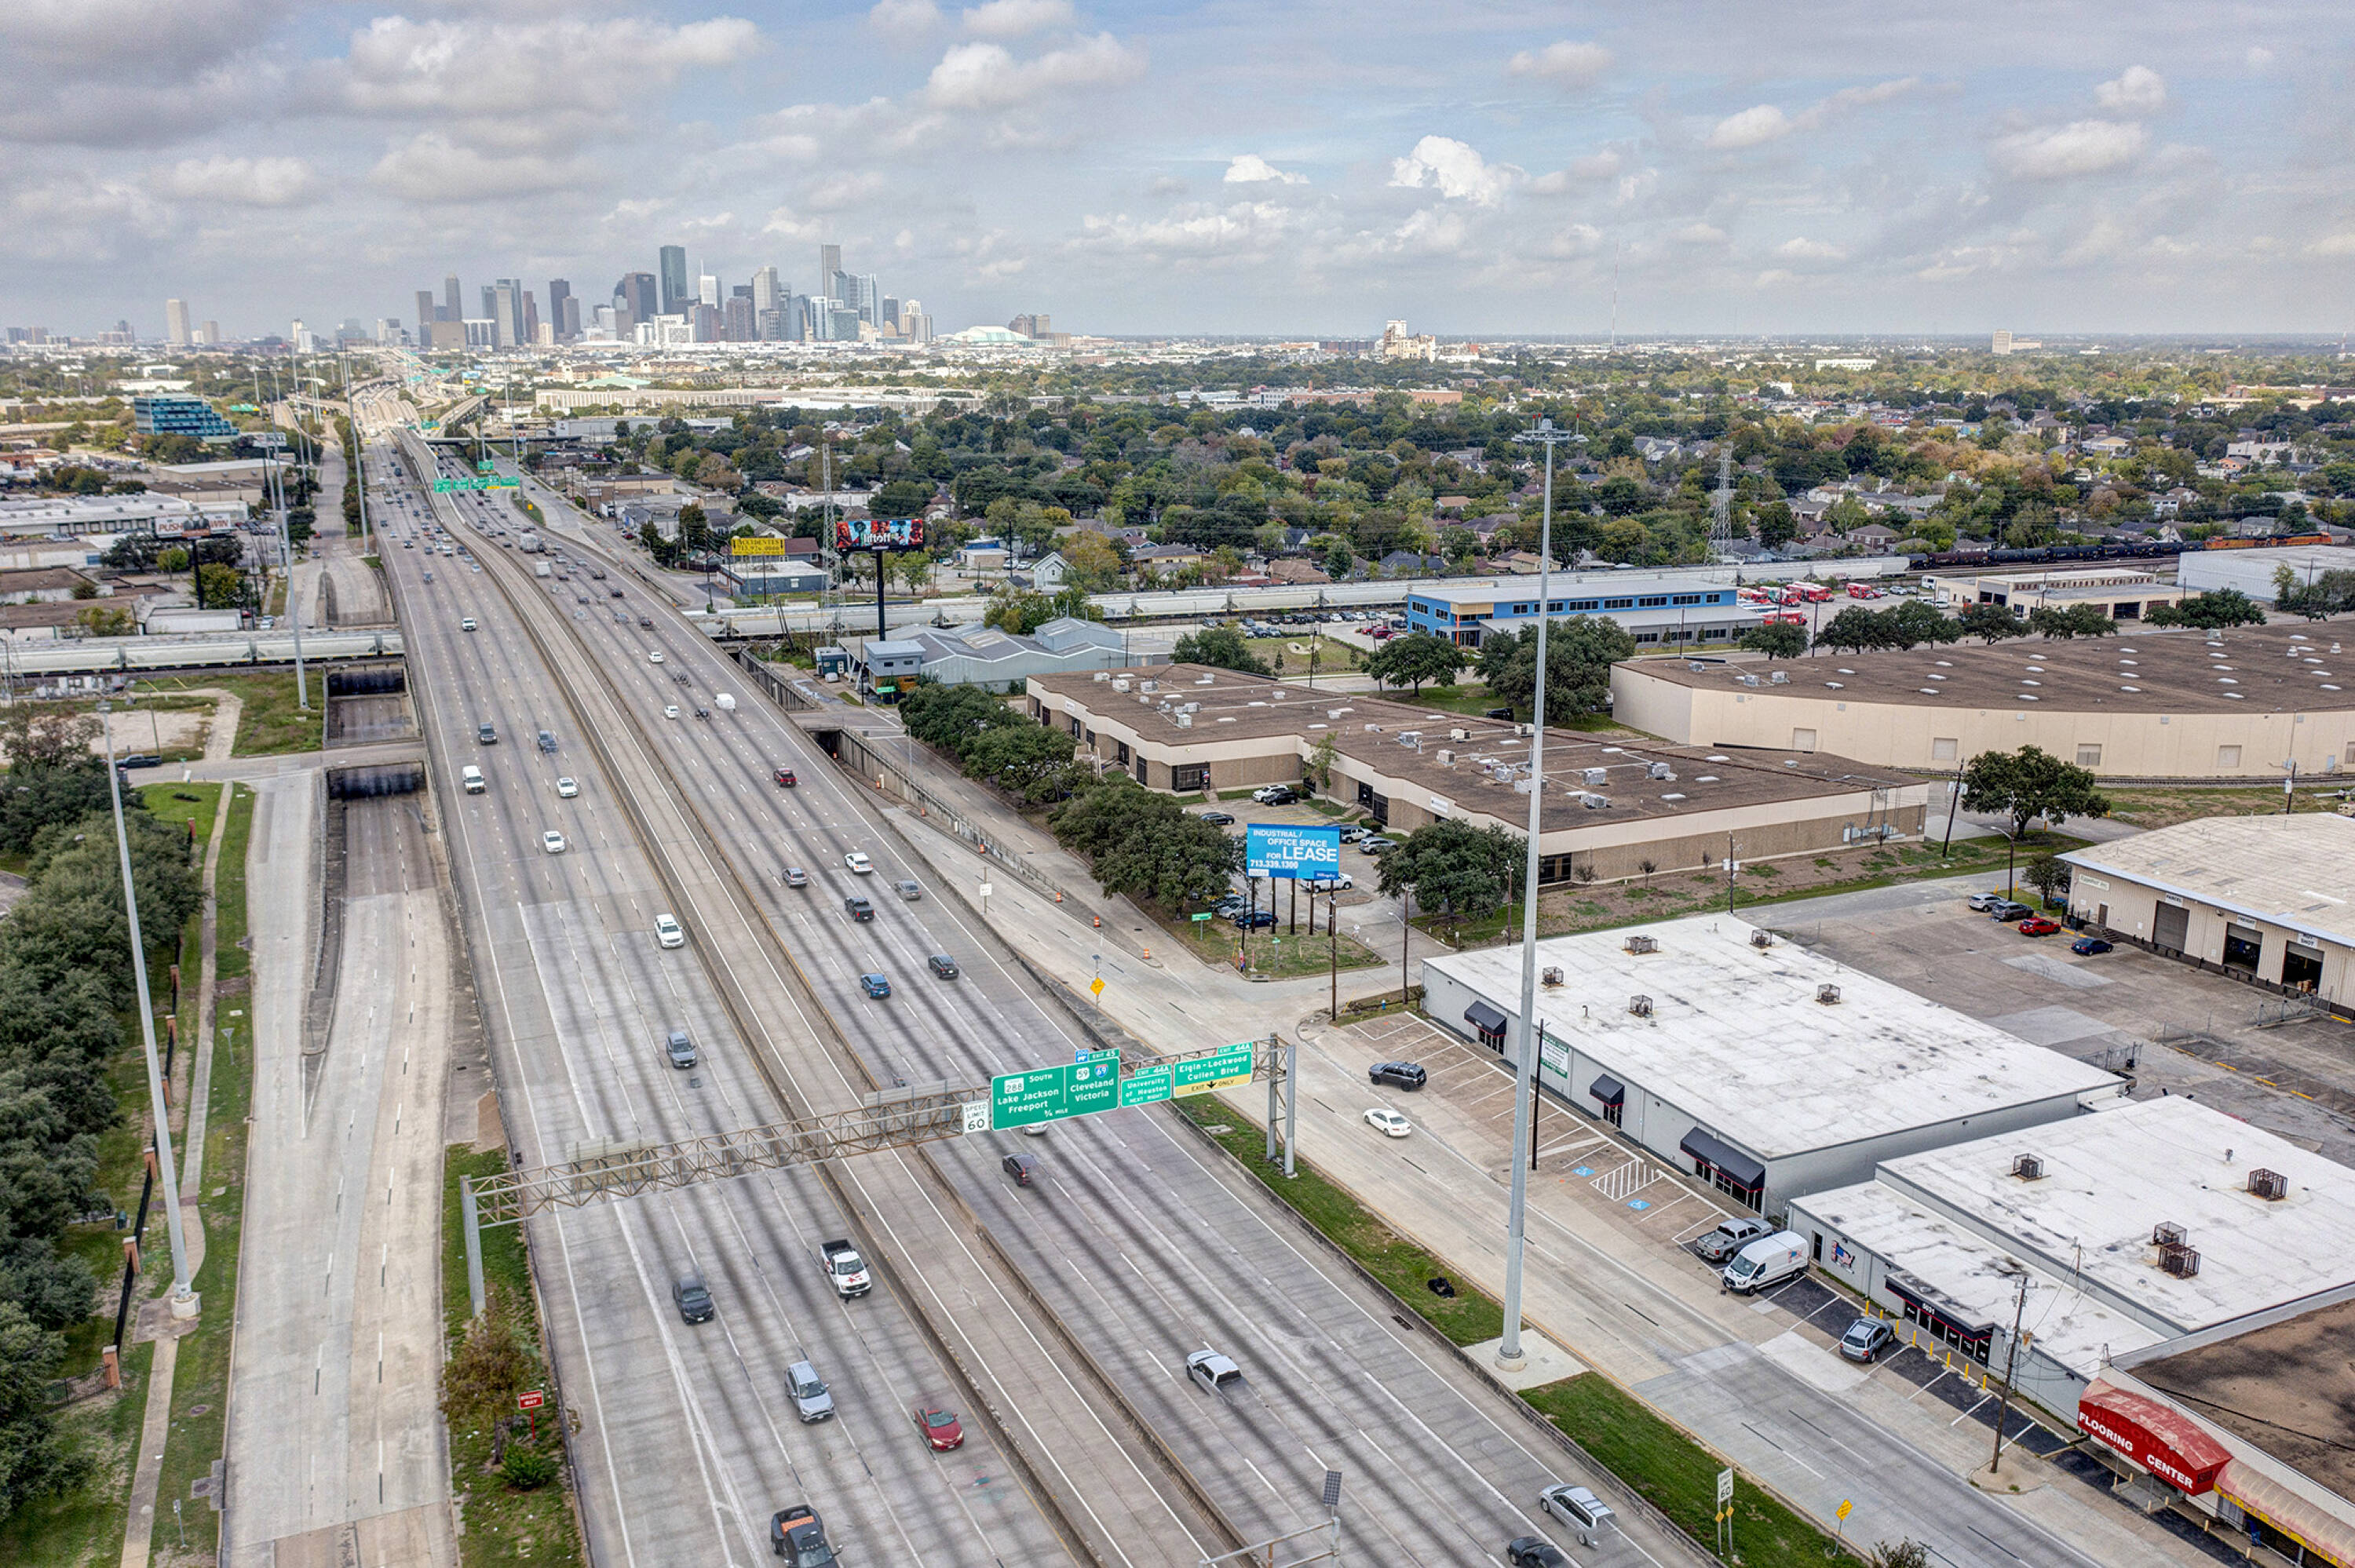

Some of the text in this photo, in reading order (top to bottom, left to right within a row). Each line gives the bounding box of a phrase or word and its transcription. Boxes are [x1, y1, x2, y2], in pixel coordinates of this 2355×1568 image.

[1299, 839, 1327, 848] SPACE
[1283, 846, 1338, 862] LEASE
[1077, 1067, 1107, 1080] 59 69
[1188, 1066, 1239, 1081] Cullen Blvd
[1006, 1083, 1023, 1092] 288
[1070, 1078, 1115, 1092] Cleveland
[1127, 1078, 1165, 1089] University
[1075, 1090, 1109, 1102] Victoria
[1138, 1085, 1167, 1095] Houston
[998, 1088, 1059, 1105] Lake Jackson
[1008, 1100, 1048, 1114] Freeport
[968, 1118, 985, 1130] 60
[2079, 1411, 2193, 1490] FLOORING CENTER
[1720, 1479, 1730, 1489] LIMIT
[1720, 1486, 1732, 1498] 60
